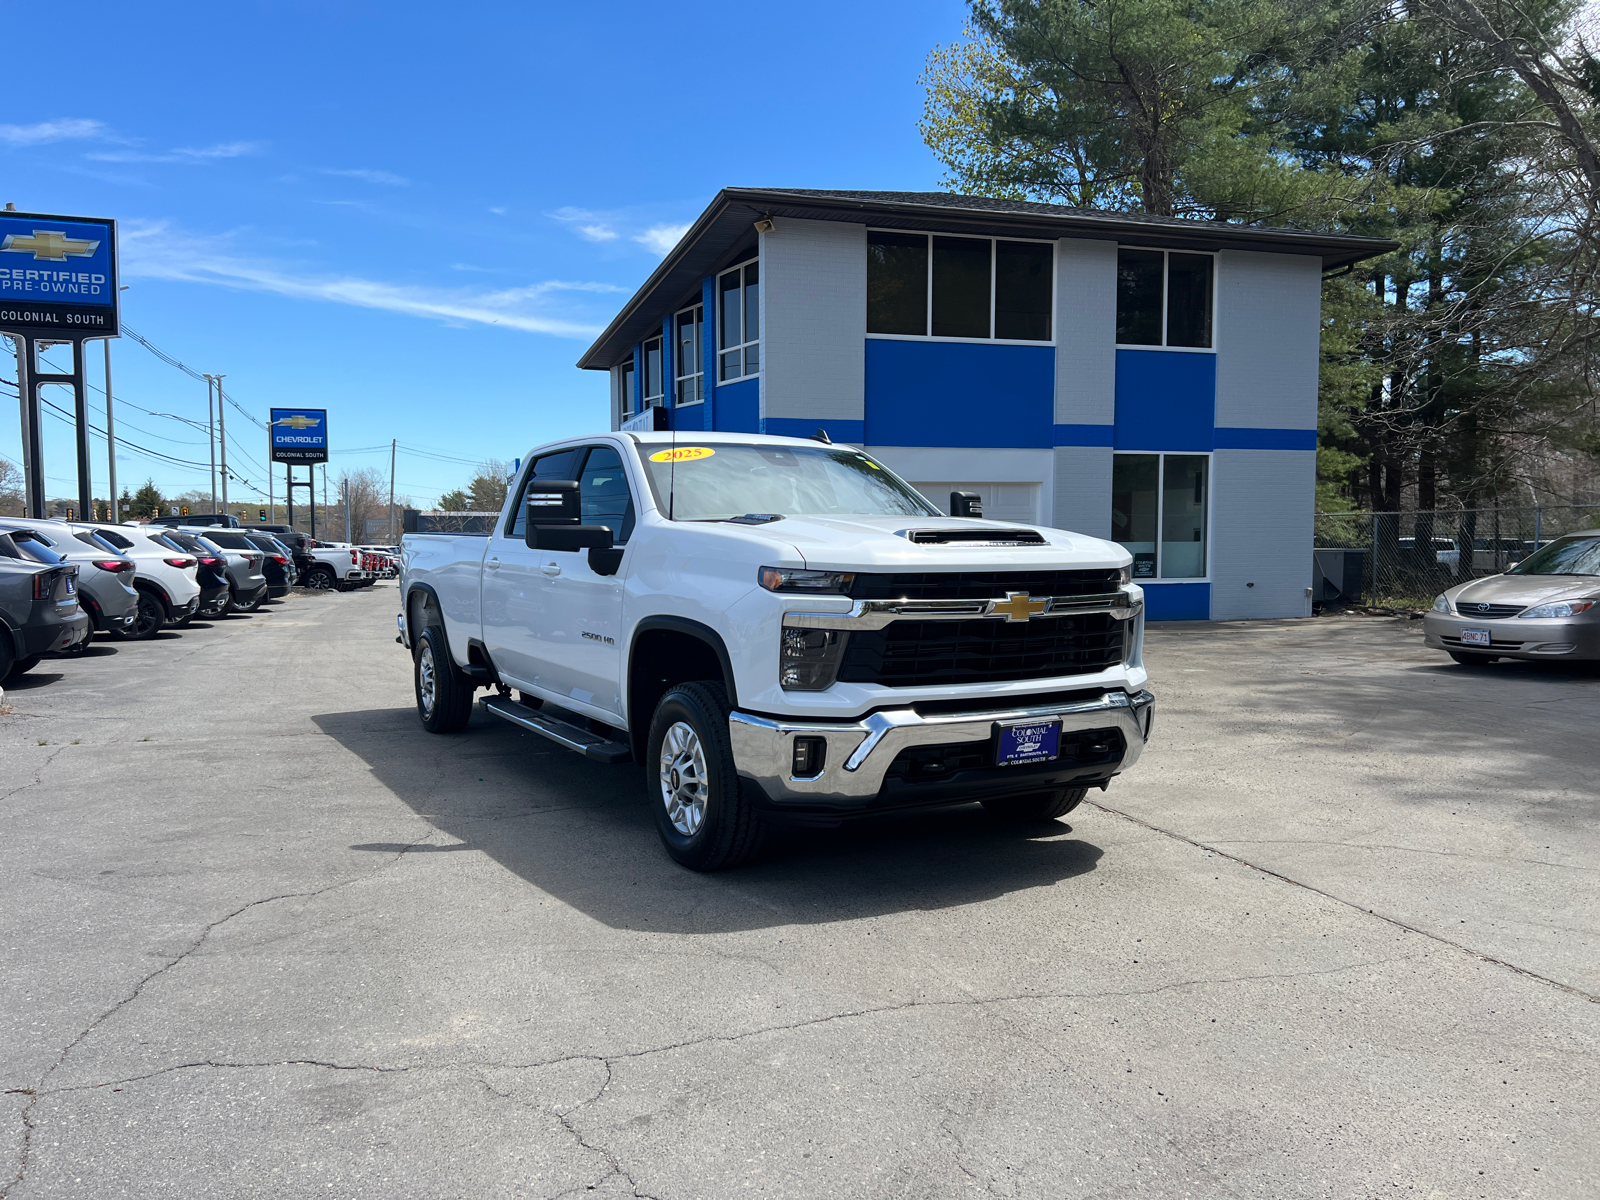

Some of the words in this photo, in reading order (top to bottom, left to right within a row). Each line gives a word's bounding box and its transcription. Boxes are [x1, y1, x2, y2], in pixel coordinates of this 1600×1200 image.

[0, 268, 105, 284] CERTIFIED
[2, 280, 101, 295] PRE-OWNED
[1, 310, 59, 323] COLONIAL
[66, 313, 104, 325] SOUTH
[276, 436, 323, 444] CHEVROLET
[663, 448, 702, 461] 2025
[581, 630, 602, 642] 2500
[1480, 633, 1488, 642] 71
[1011, 727, 1048, 738] COLONIAL
[1016, 734, 1042, 744] SOUTH
